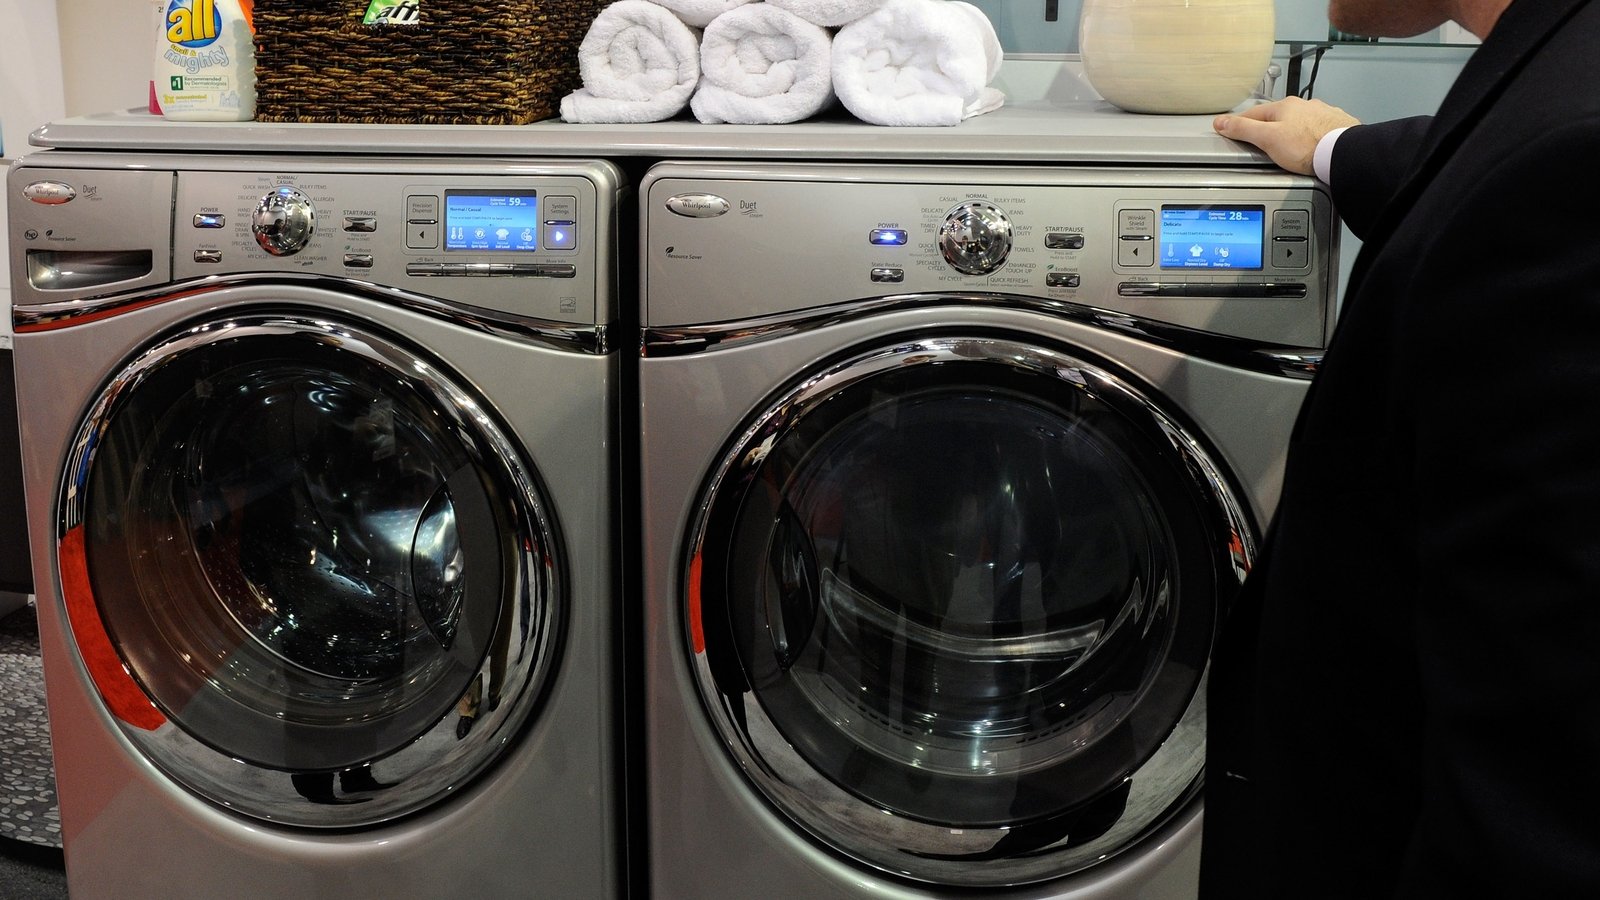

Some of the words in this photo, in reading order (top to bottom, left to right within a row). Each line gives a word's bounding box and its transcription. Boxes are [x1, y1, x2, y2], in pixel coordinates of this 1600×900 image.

[167, 0, 216, 43] all
[163, 45, 230, 74] mighty
[82, 185, 97, 193] Duet
[509, 198, 520, 206] 59
[682, 202, 711, 210] Whirlpool
[740, 200, 757, 209] Duet
[1229, 211, 1242, 220] 28
